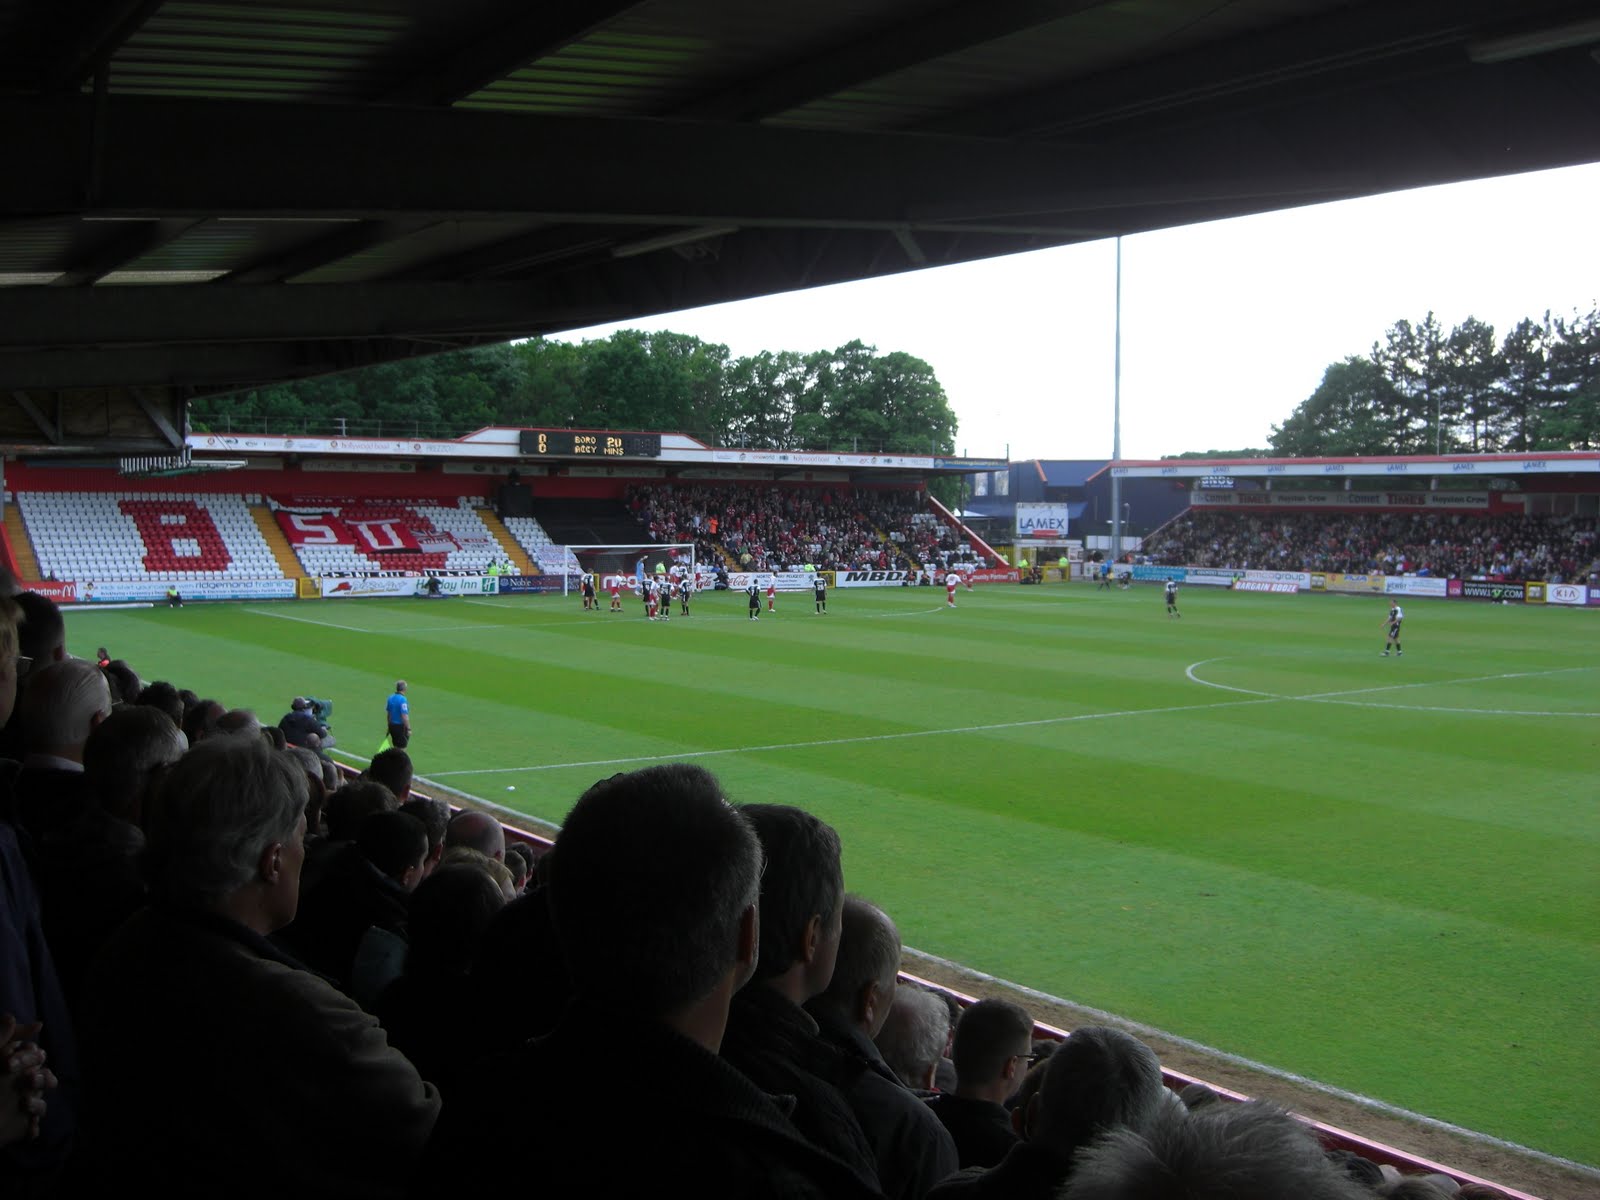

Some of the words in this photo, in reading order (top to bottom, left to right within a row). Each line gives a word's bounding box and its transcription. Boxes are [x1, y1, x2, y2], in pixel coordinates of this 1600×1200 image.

[575, 436, 596, 444] BORO
[607, 437, 622, 448] 20
[604, 447, 624, 456] MINS
[1325, 463, 1345, 472] LAMEX
[1387, 463, 1408, 472] LAMEX
[1453, 462, 1475, 471] LAMEX
[1523, 461, 1547, 470] LAMEX
[1348, 493, 1380, 503] Comet
[1387, 493, 1426, 505] TIMES
[1020, 518, 1064, 529] LAMEX
[195, 581, 253, 590] ridgemond
[254, 580, 294, 589] training
[460, 579, 477, 590] Inn
[509, 577, 532, 586] Noble
[1235, 581, 1269, 591] BARGAIN
[1271, 582, 1297, 592] BOOZE
[1556, 589, 1576, 598] KIA
